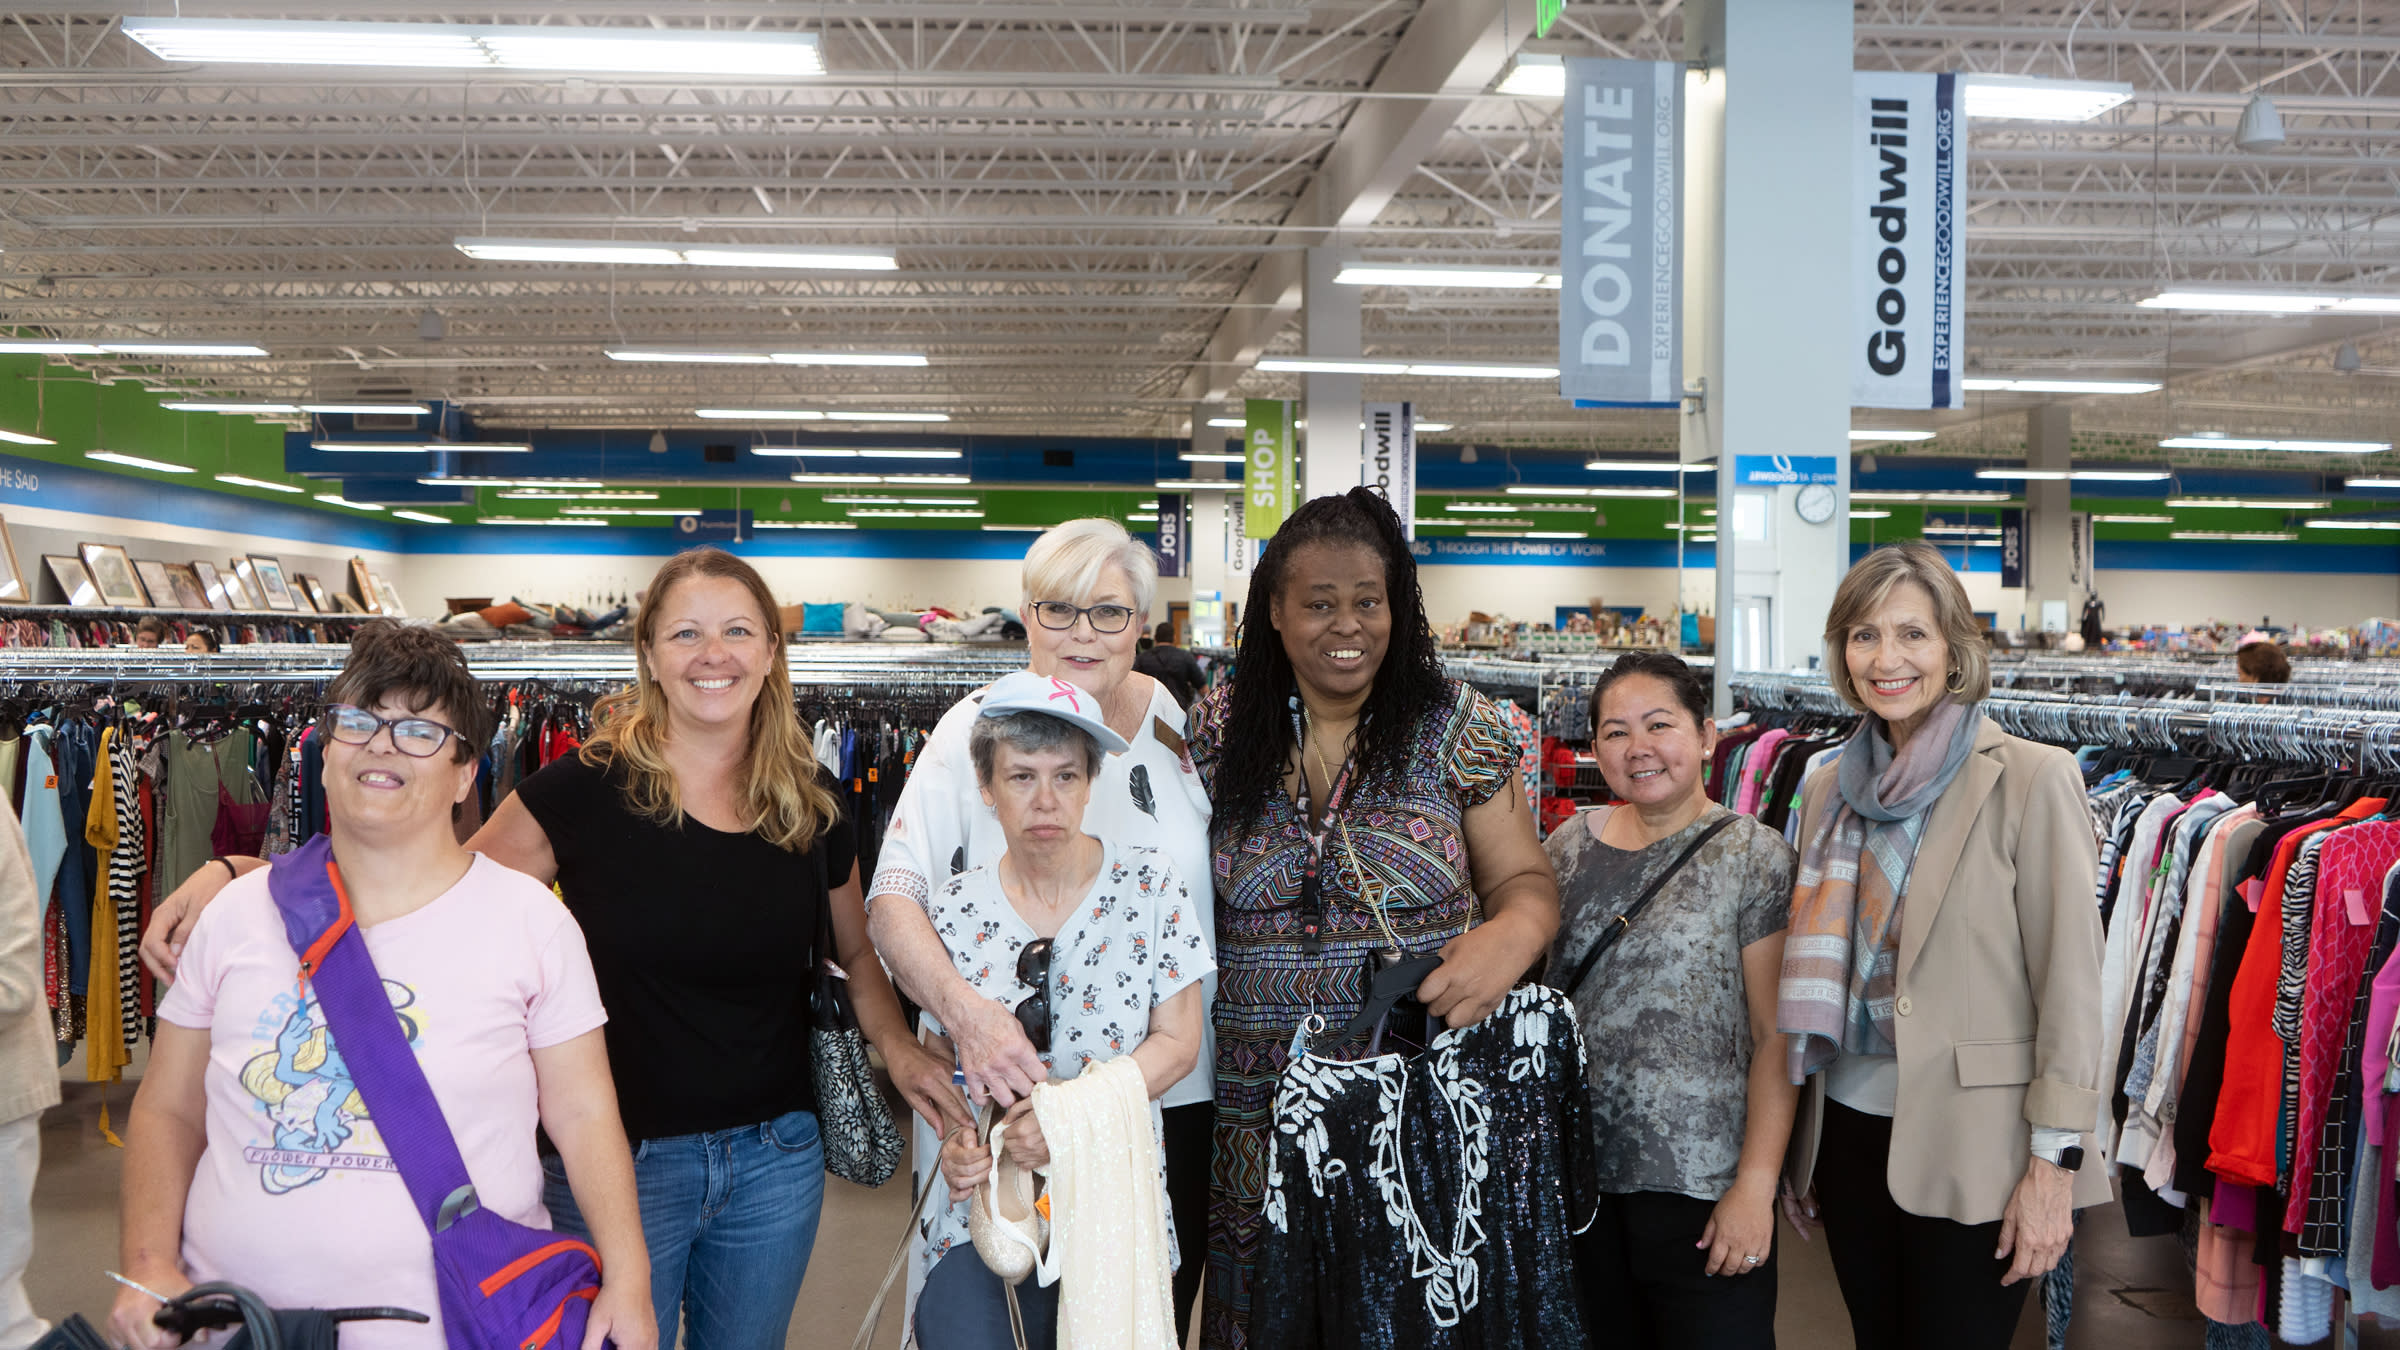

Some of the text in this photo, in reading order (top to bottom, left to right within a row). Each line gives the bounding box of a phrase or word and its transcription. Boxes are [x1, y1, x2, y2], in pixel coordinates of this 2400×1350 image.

[1581, 84, 1633, 366] DONATE
[1654, 96, 1672, 361] EXPERIENCEGOODWILL.ORG
[1868, 98, 1908, 377] Goodwill
[1934, 108, 1952, 370] EXPERIENCEGOODWILL.ORG
[15, 469, 39, 492] SAID
[1253, 428, 1276, 508] SHOP
[1374, 411, 1391, 501] oodwill
[1161, 513, 1177, 557] JOBS
[1512, 541, 1551, 556] POWER
[1552, 543, 1568, 556] OF
[1570, 542, 1606, 557] WORK
[2005, 526, 2019, 570] JOBS
[251, 981, 317, 1041] PEAC
[250, 1150, 396, 1170] FLOWER POWER
